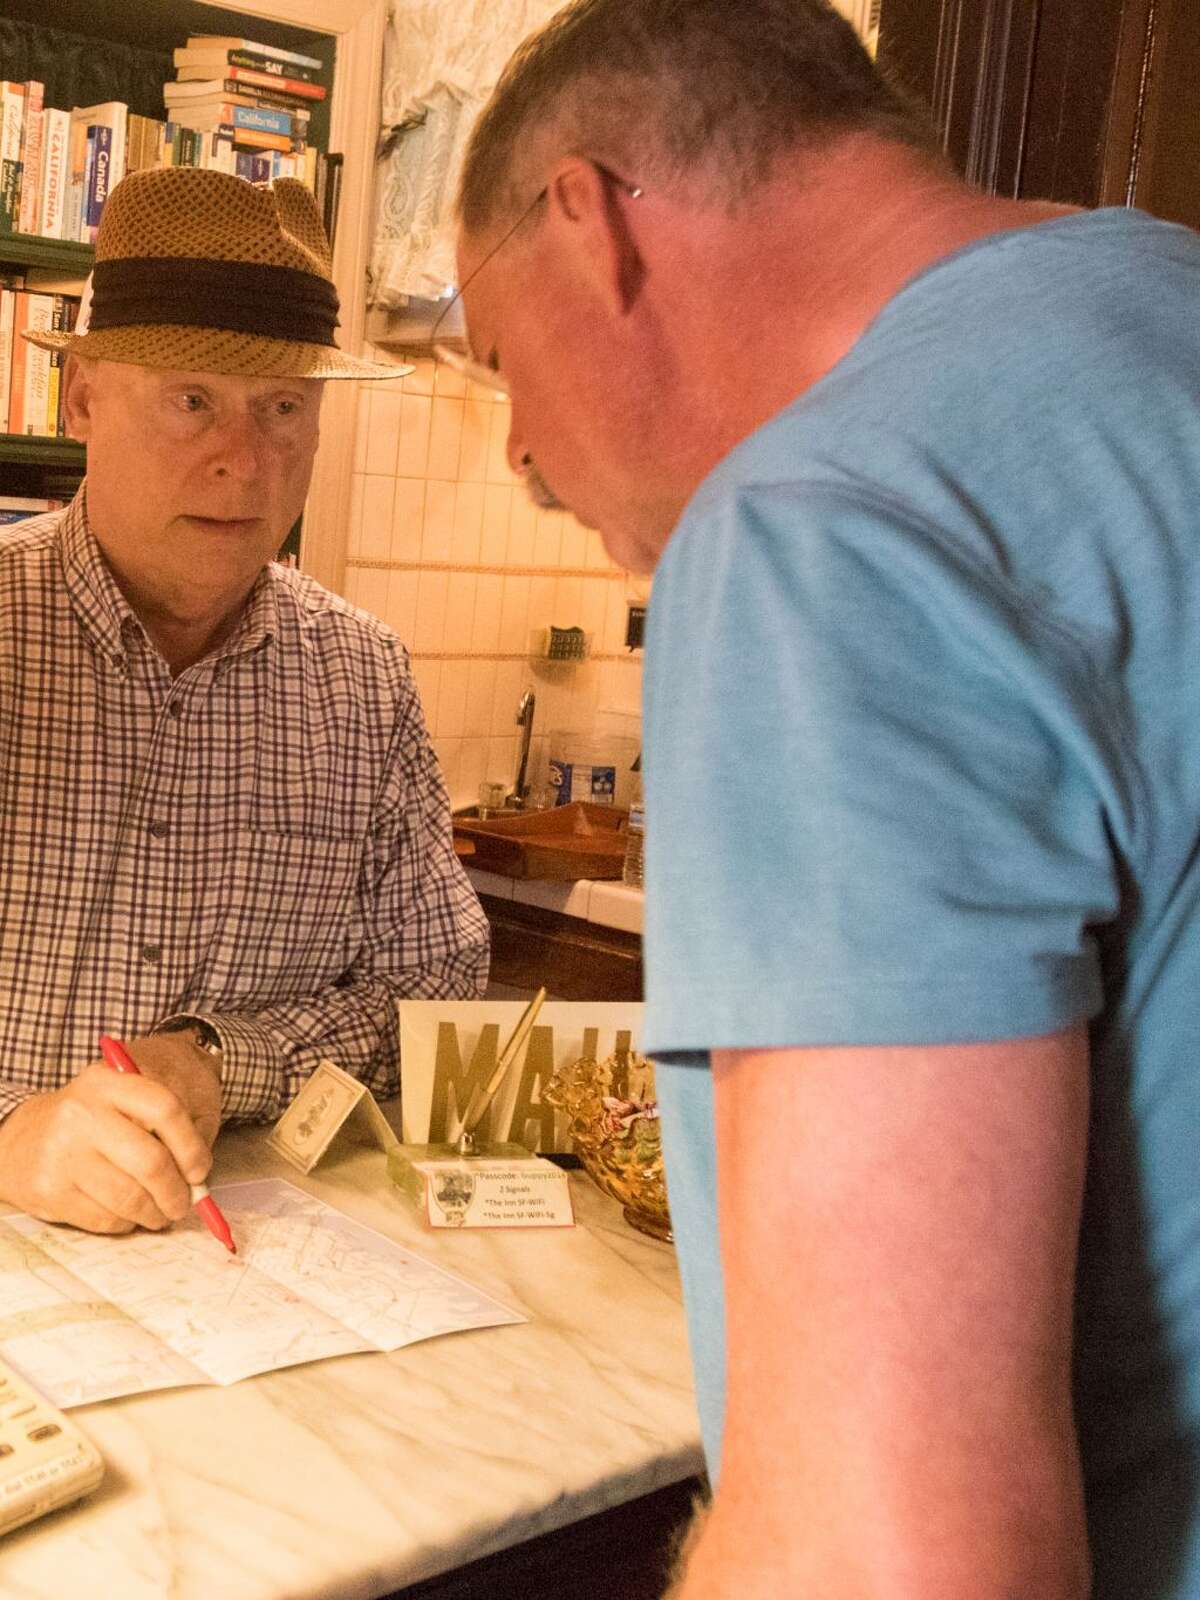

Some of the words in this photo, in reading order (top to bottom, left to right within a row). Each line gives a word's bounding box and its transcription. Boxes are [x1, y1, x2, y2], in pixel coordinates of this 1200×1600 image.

[237, 111, 280, 129] California
[46, 134, 61, 229] CALIFORNIA
[95, 151, 109, 203] Canada
[428, 1021, 632, 1153] MA
[506, 1185, 530, 1194] Signals
